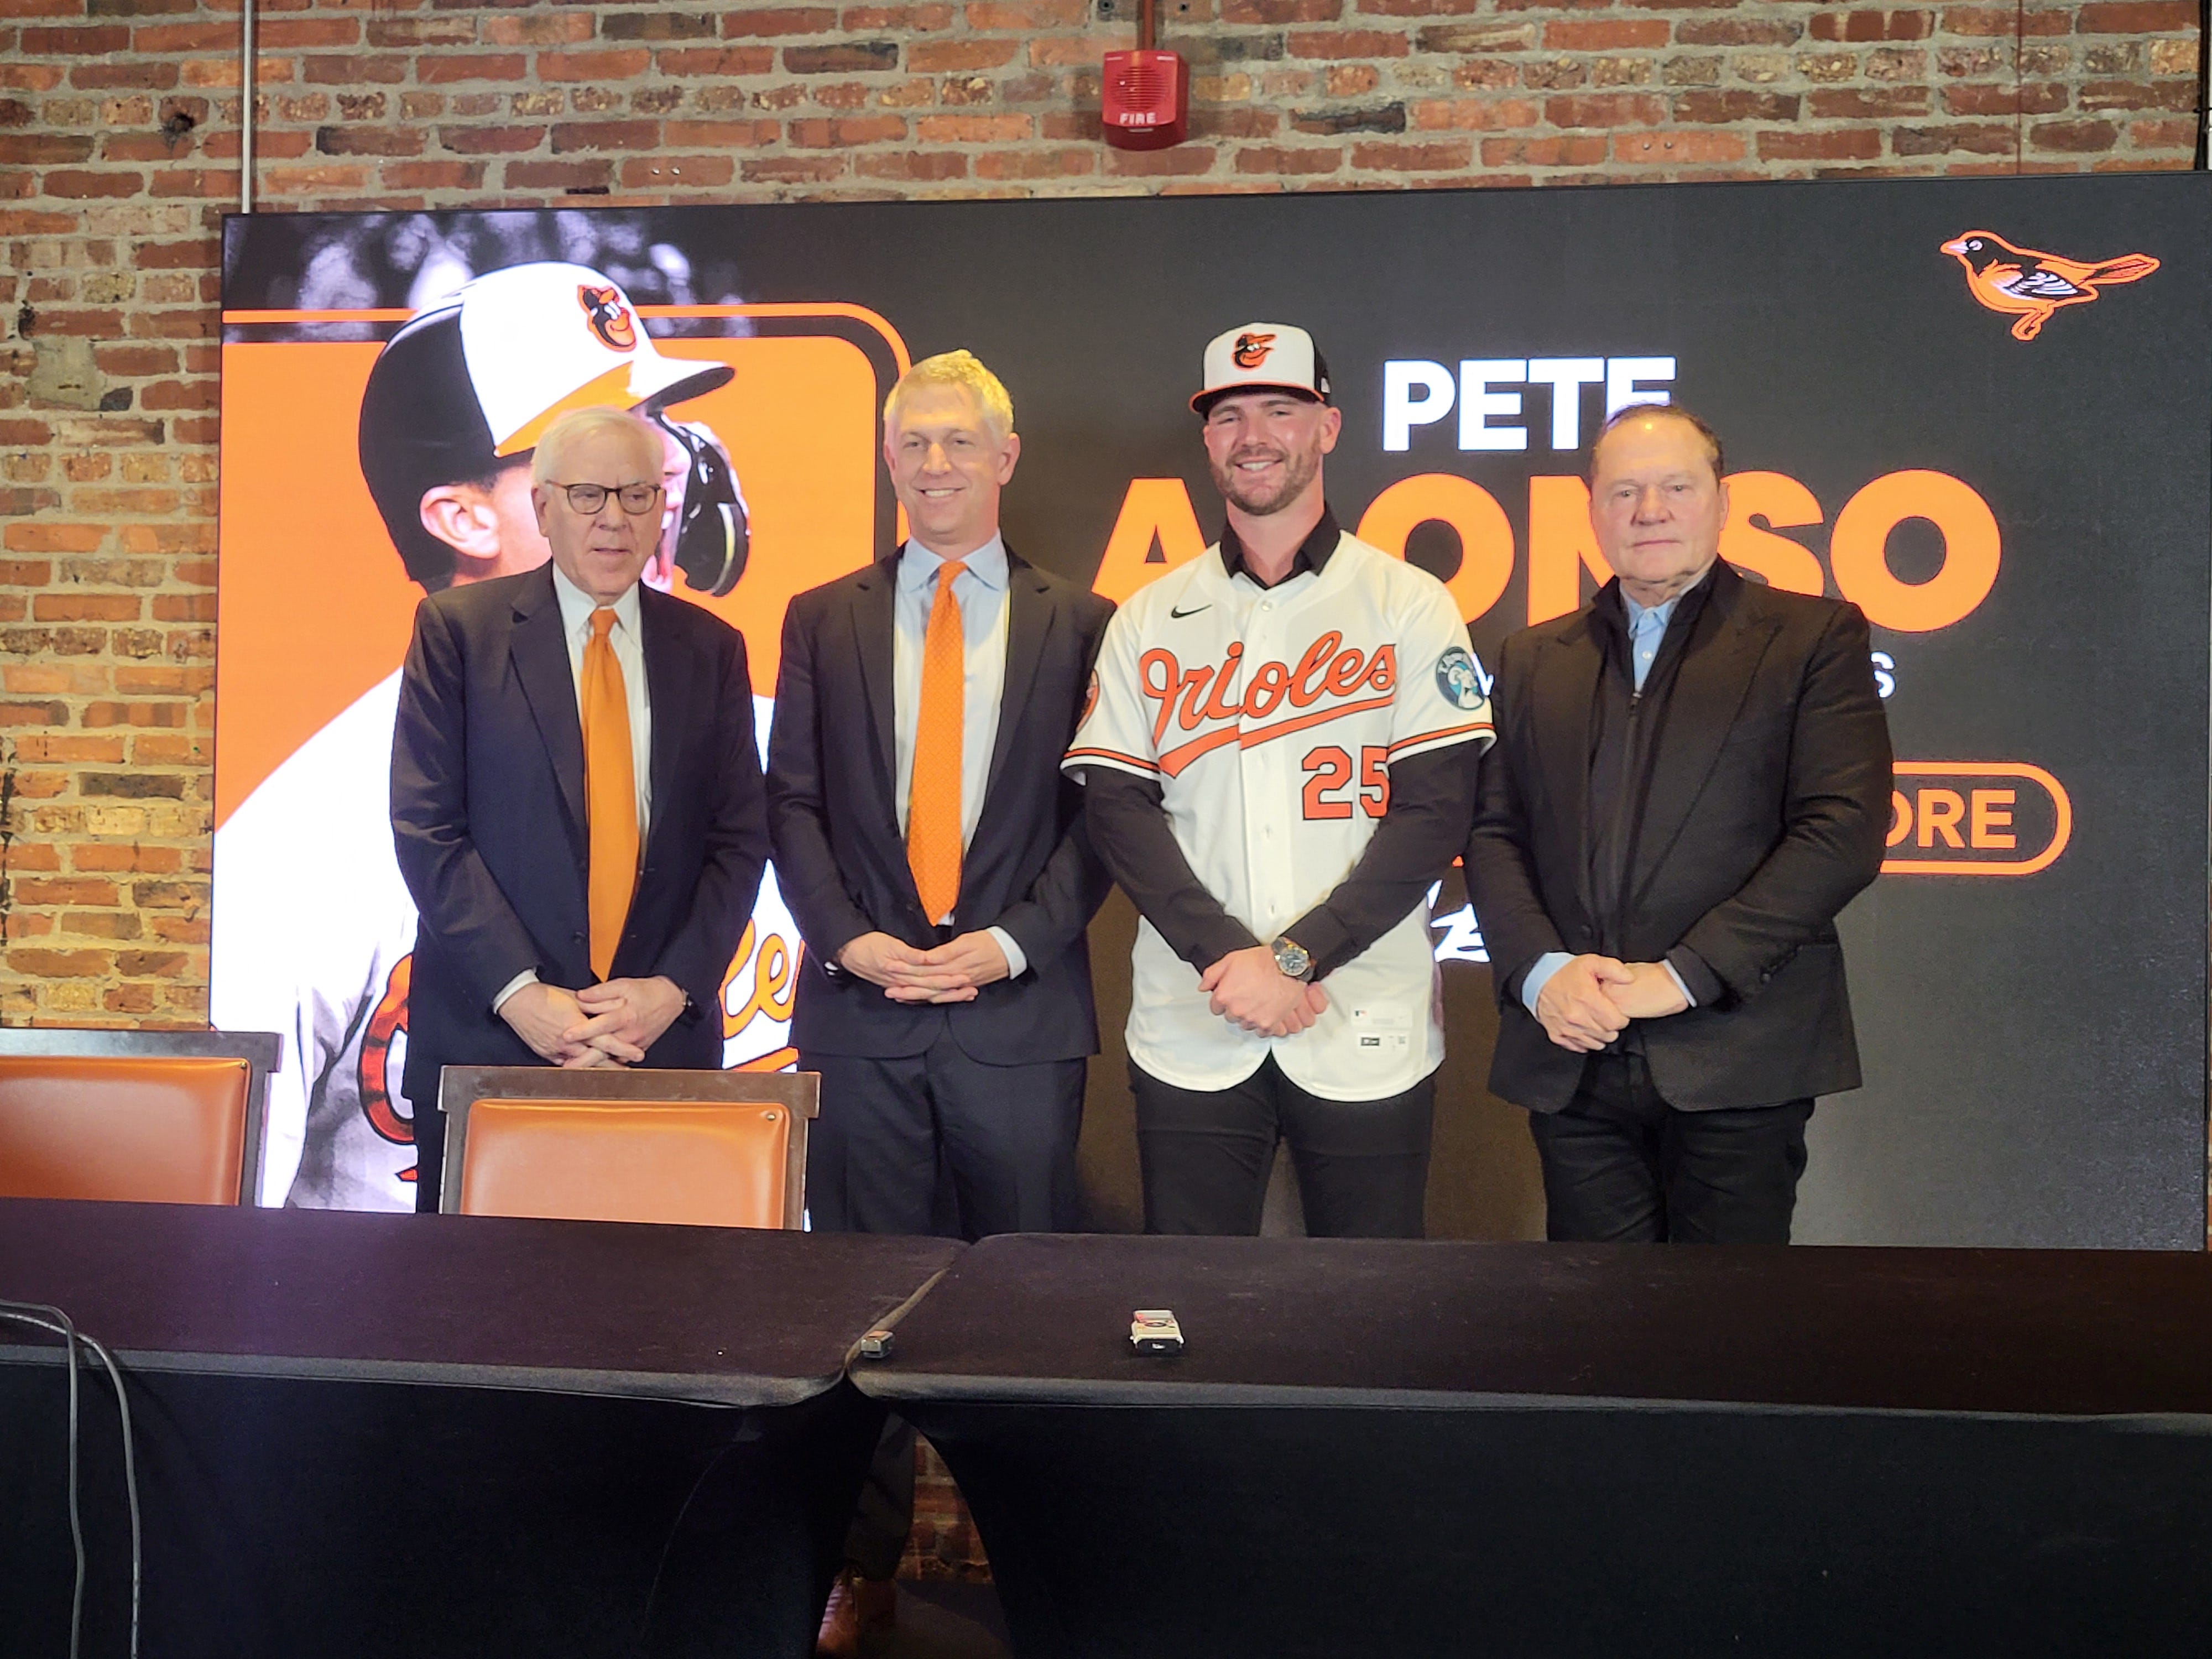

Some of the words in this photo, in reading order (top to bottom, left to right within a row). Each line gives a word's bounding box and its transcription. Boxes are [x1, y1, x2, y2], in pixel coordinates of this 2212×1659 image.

[1119, 112, 1156, 124] FIRE
[1139, 630, 1397, 749] Orioles
[1301, 745, 1390, 821] 25
